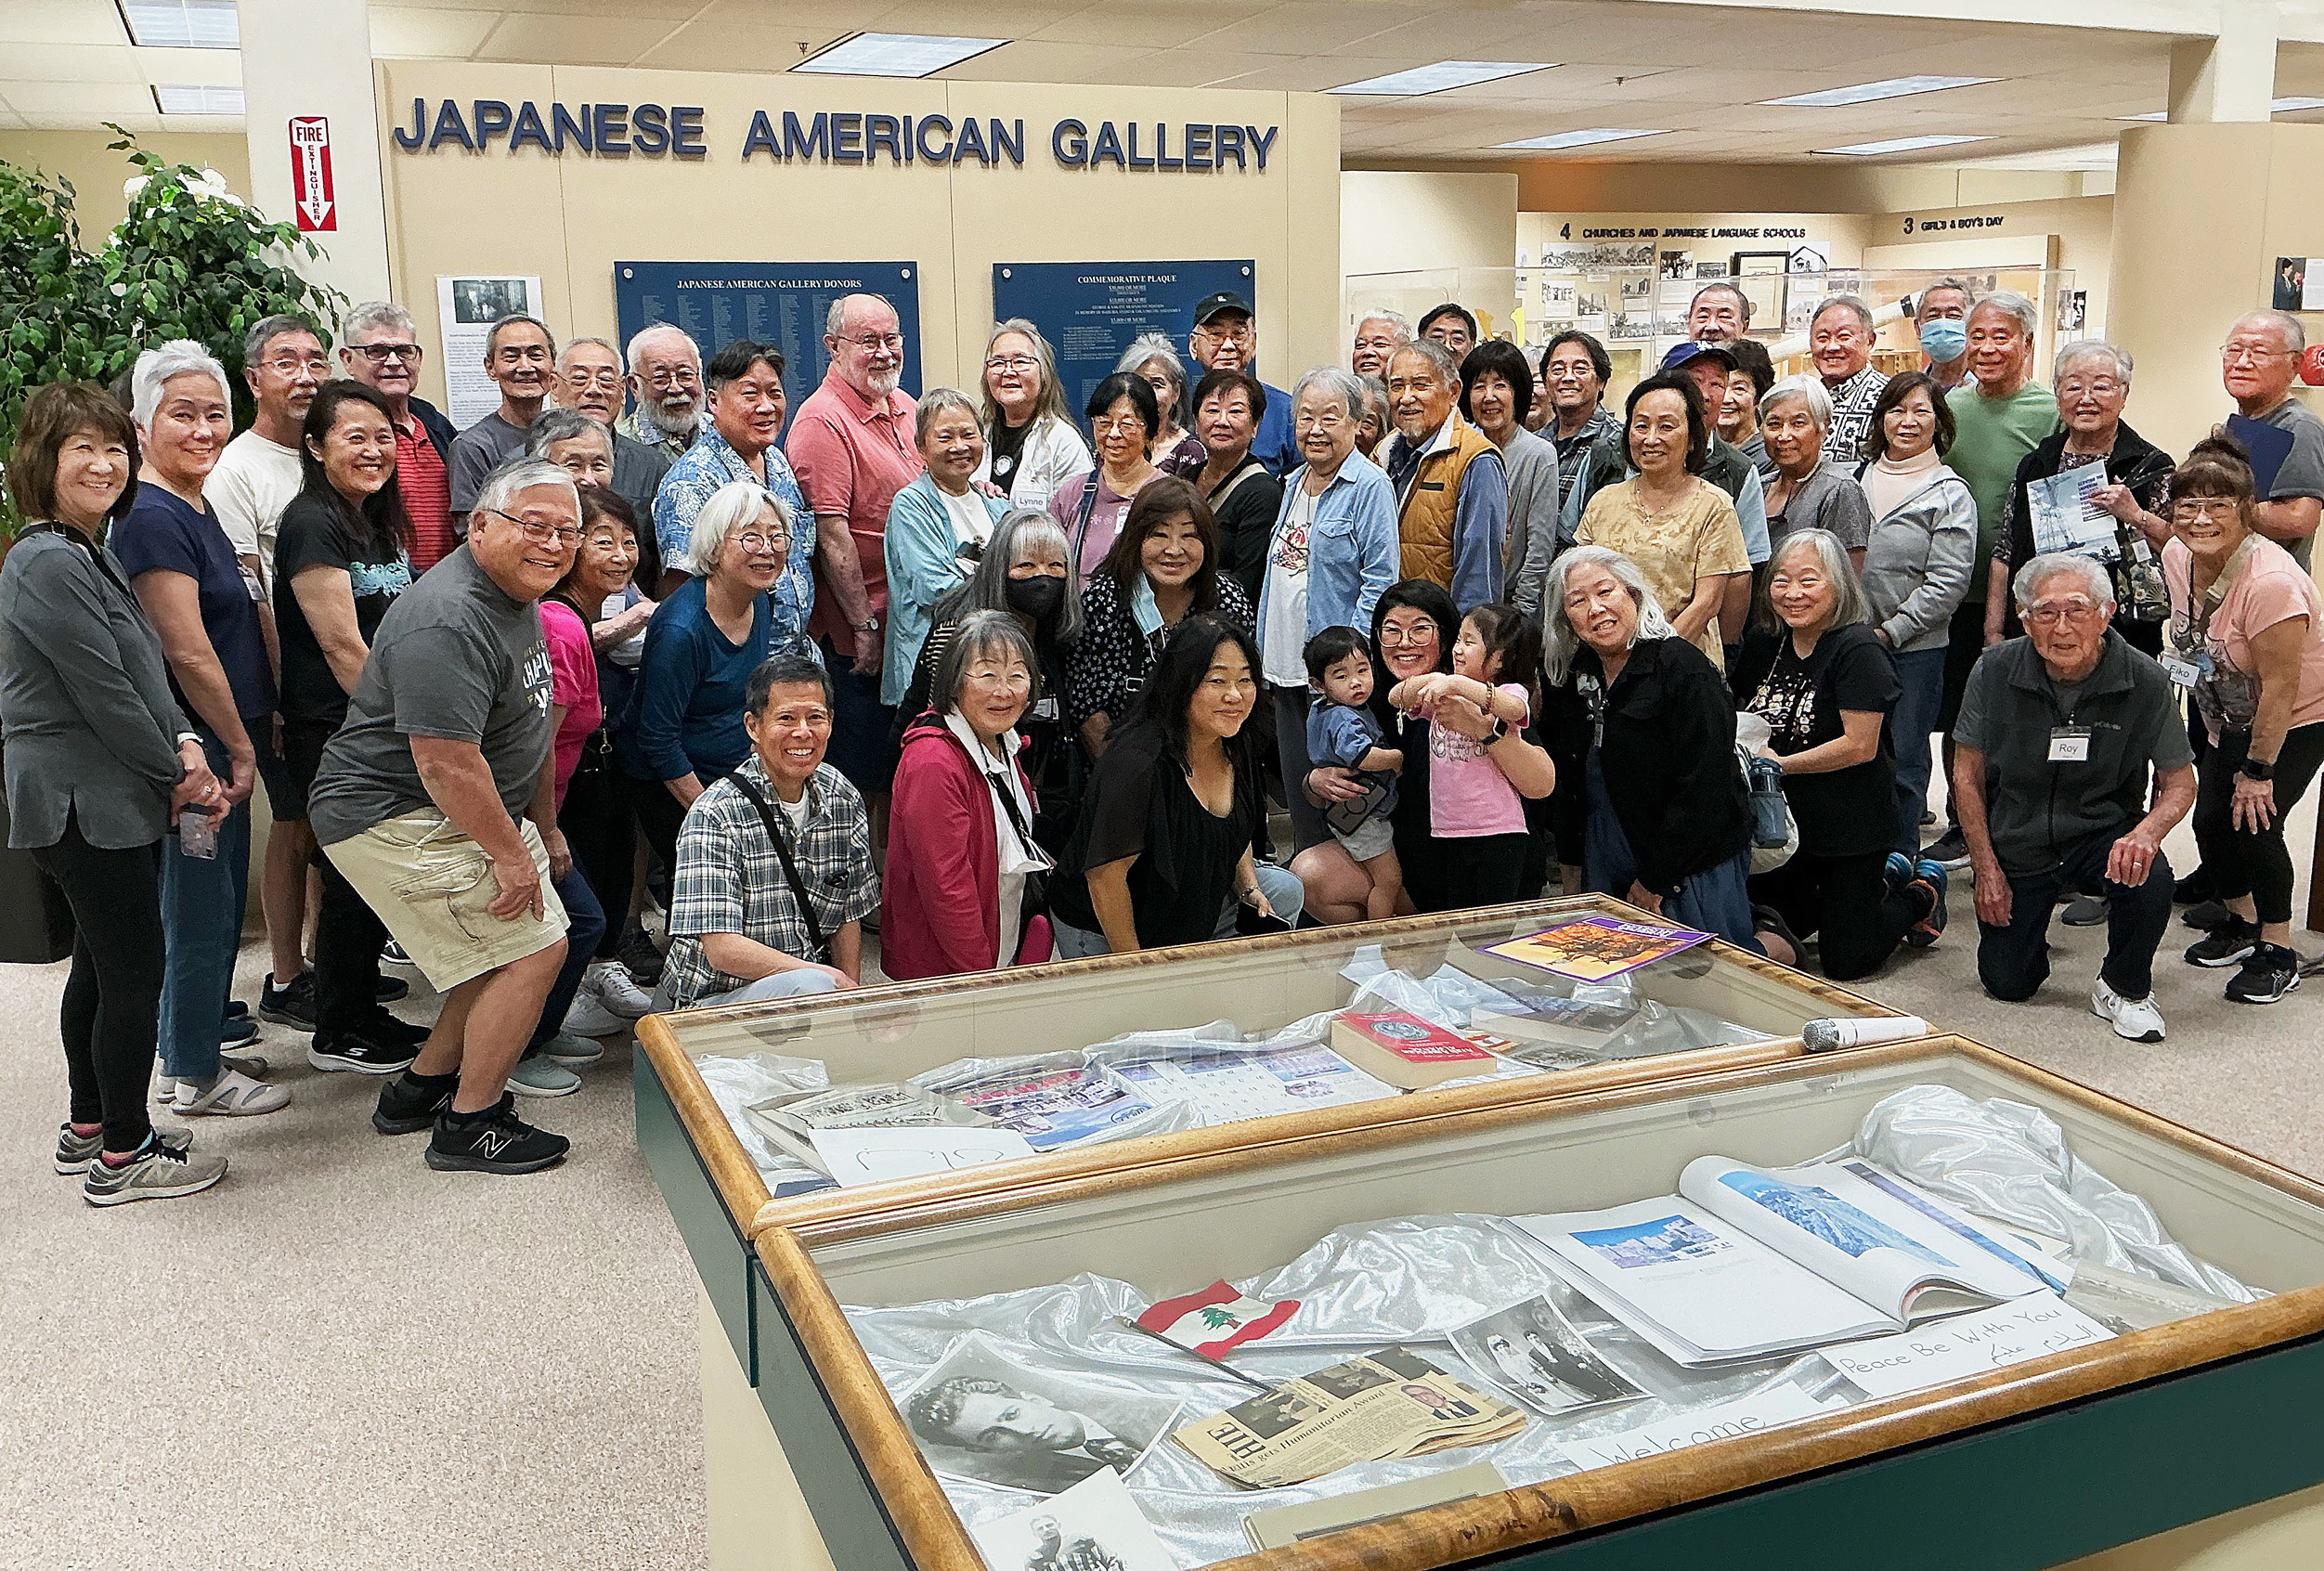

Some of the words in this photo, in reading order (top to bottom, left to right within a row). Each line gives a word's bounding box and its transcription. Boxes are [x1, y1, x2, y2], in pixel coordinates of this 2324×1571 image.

[296, 127, 324, 142] FIRE
[394, 97, 707, 161] JAPANESE
[743, 110, 1023, 168] AMERICAN
[1051, 118, 1279, 174] GALLERY
[307, 144, 321, 221] EXTINGUISHER
[1560, 223, 1571, 240] 4
[1582, 228, 1635, 238] CHURCHES
[1638, 228, 1658, 238] AND
[1662, 228, 1709, 238] JAPANESE
[1711, 228, 1760, 238] LANGUAGE
[1762, 228, 1806, 238] SCHOOLS
[1903, 217, 1914, 234] 3
[1986, 216, 2005, 227] DAY
[677, 280, 724, 289] JAPANESE
[726, 280, 776, 289] AMERICAN
[778, 280, 822, 289] GALLERY
[824, 279, 863, 288] DONORS
[1077, 275, 1146, 284] COMMEMORATIVE
[1147, 275, 1177, 284] PLAQUE
[1019, 497, 1044, 507] Lynne
[2169, 664, 2190, 678] Eiko
[2058, 744, 2079, 755] Roy
[1839, 1355, 1912, 1374] Peace
[1910, 1343, 1951, 1357] Be
[1952, 1321, 2016, 1344] With
[2013, 1308, 2062, 1323] You
[1279, 1405, 1354, 1449] Humanitarian
[1353, 1390, 1386, 1411] Award
[1588, 1416, 1767, 1465] Welcome
